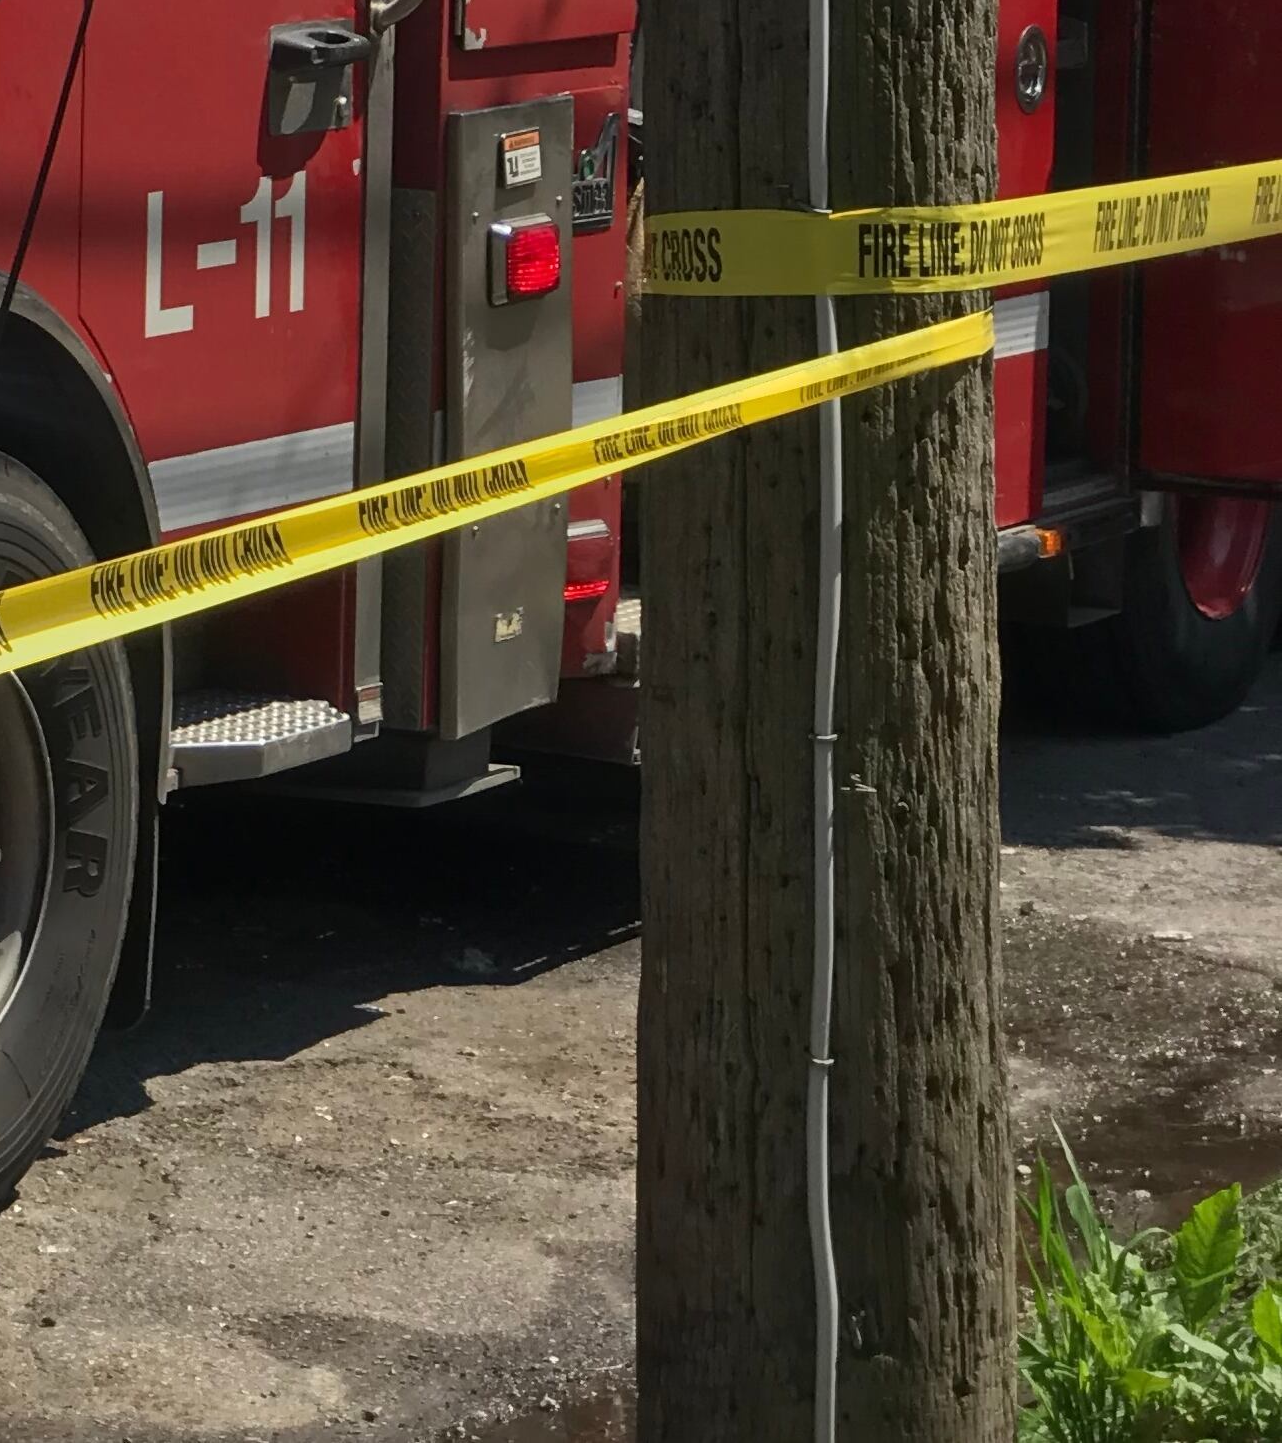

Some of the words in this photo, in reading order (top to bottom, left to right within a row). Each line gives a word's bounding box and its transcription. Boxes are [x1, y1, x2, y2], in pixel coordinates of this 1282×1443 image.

[858, 223, 911, 278] FIRE
[918, 221, 966, 277] LINE:
[969, 219, 987, 275] DO
[987, 216, 1012, 273] NOT
[1010, 211, 1046, 270] CROSS
[1093, 198, 1118, 254] FIRE
[1141, 192, 1159, 246] DO
[1178, 186, 1211, 241] CROSS
[145, 169, 307, 340] L-11
[661, 227, 723, 283] CROSS
[90, 558, 138, 620] FIRE
